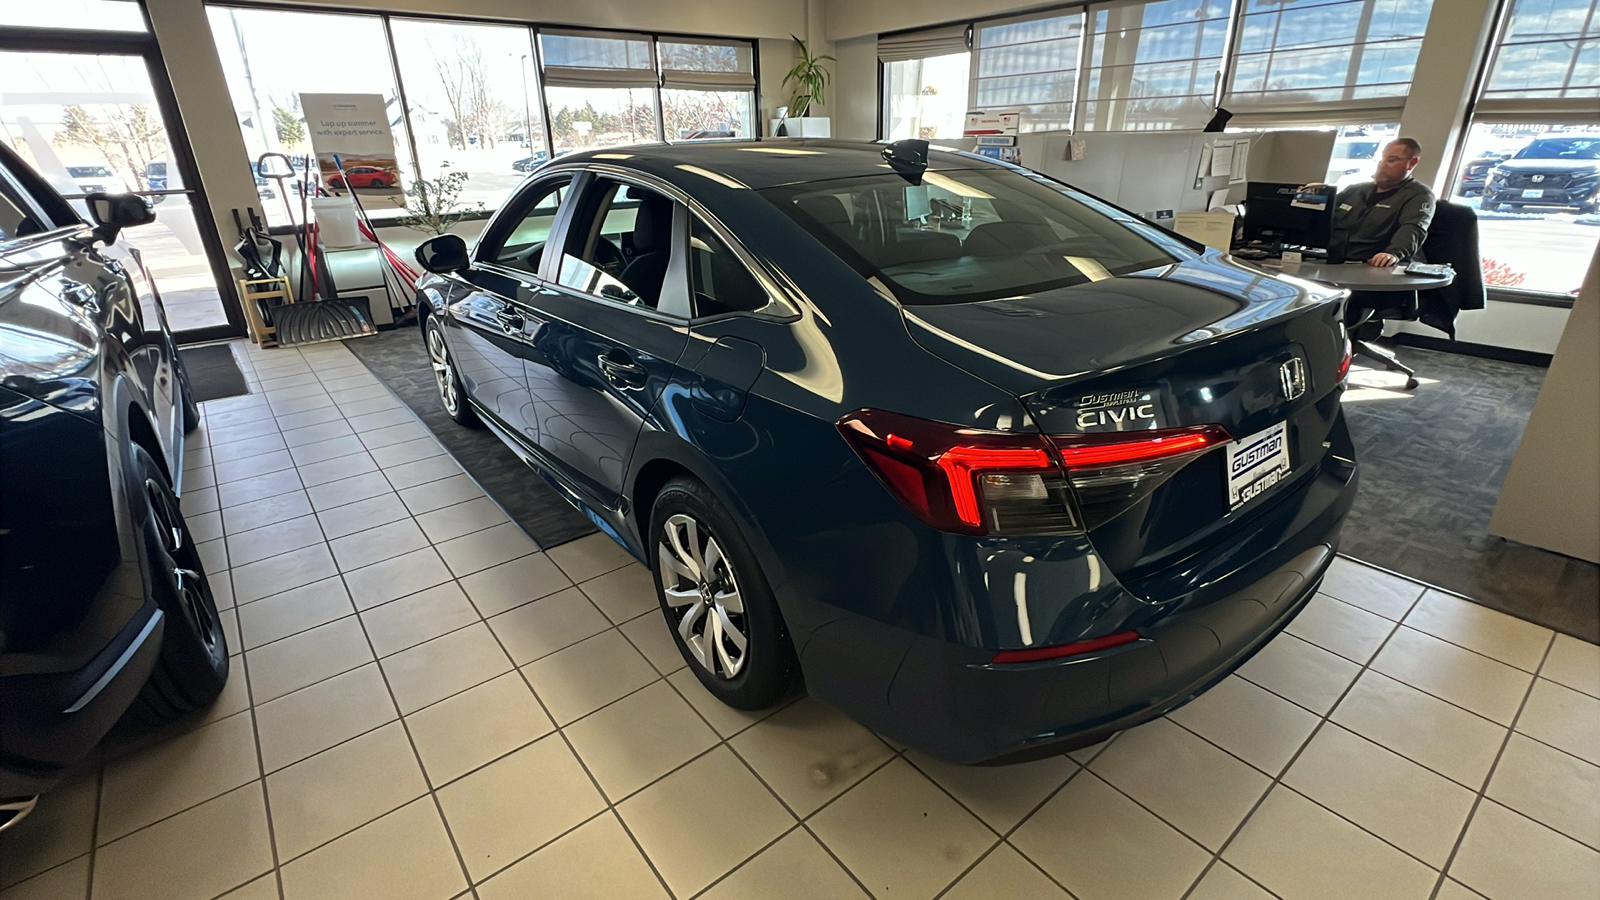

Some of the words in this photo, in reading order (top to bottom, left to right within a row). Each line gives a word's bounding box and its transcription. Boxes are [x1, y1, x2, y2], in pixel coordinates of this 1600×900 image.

[320, 120, 335, 128] Lap
[333, 129, 358, 137] expert
[1077, 404, 1155, 428] CIVIC
